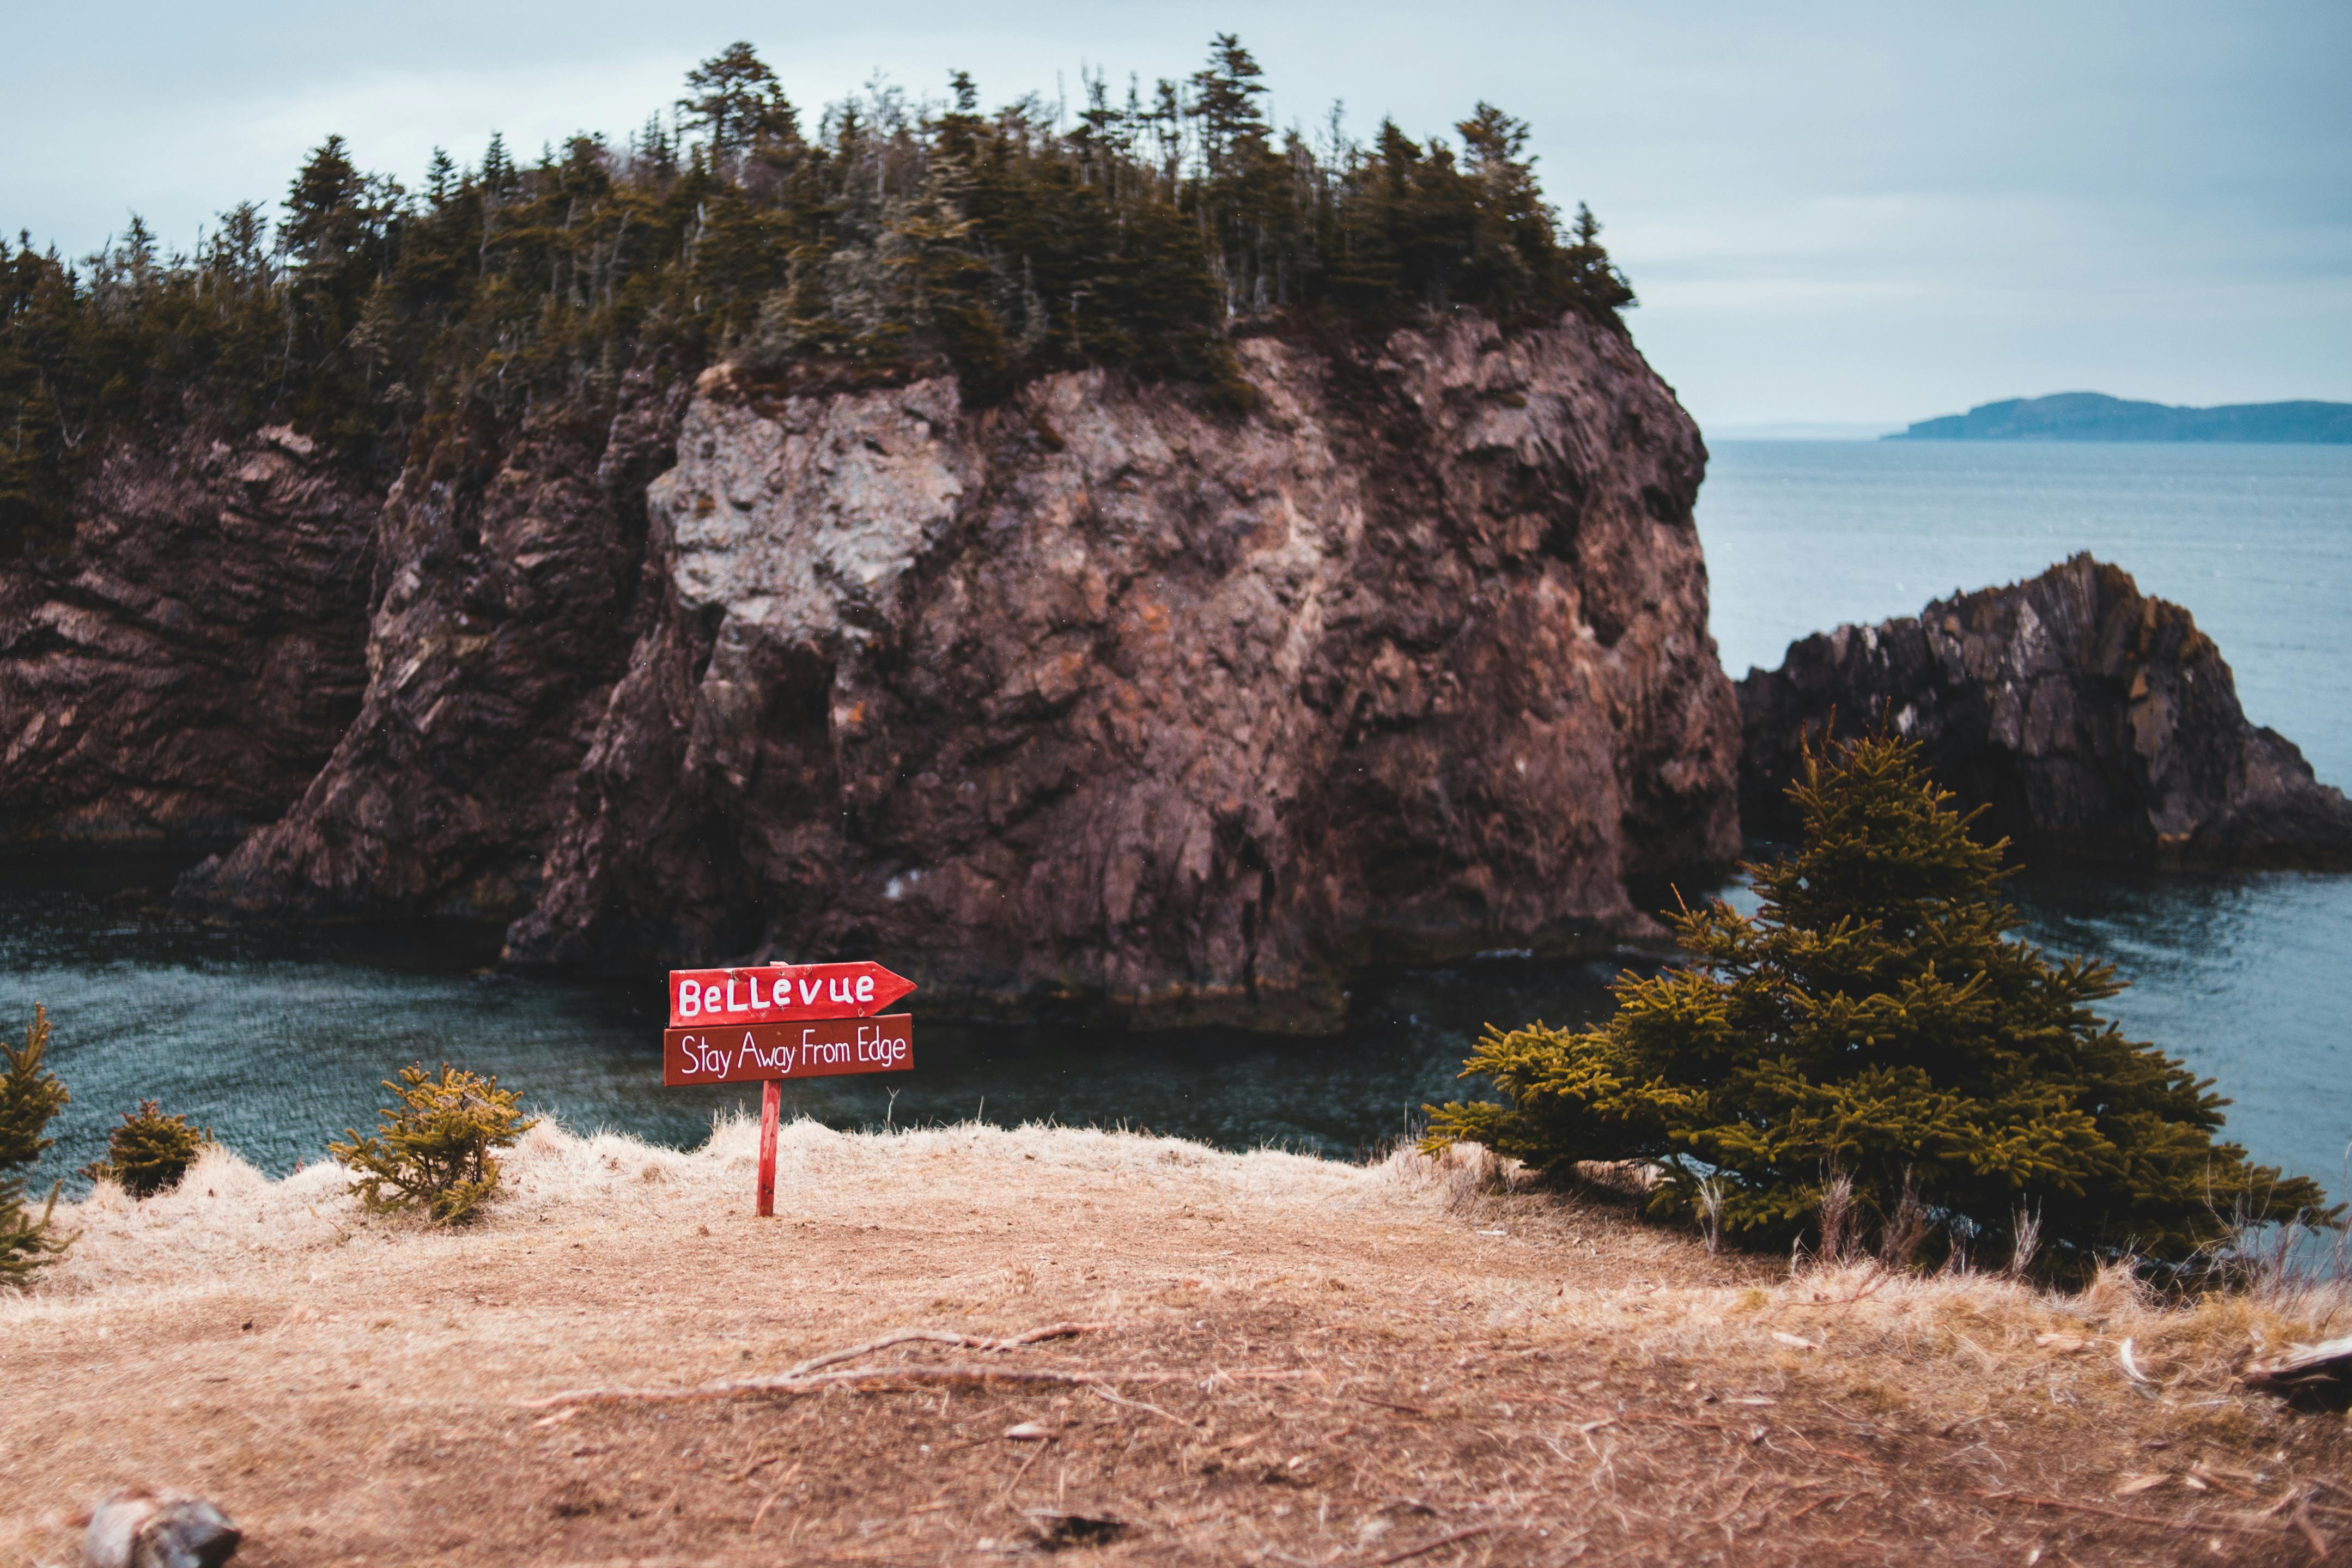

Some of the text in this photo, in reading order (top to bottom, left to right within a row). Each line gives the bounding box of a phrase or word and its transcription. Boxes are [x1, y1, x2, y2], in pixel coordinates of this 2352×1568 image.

[682, 1025, 907, 1079] Stay Away From Edge
